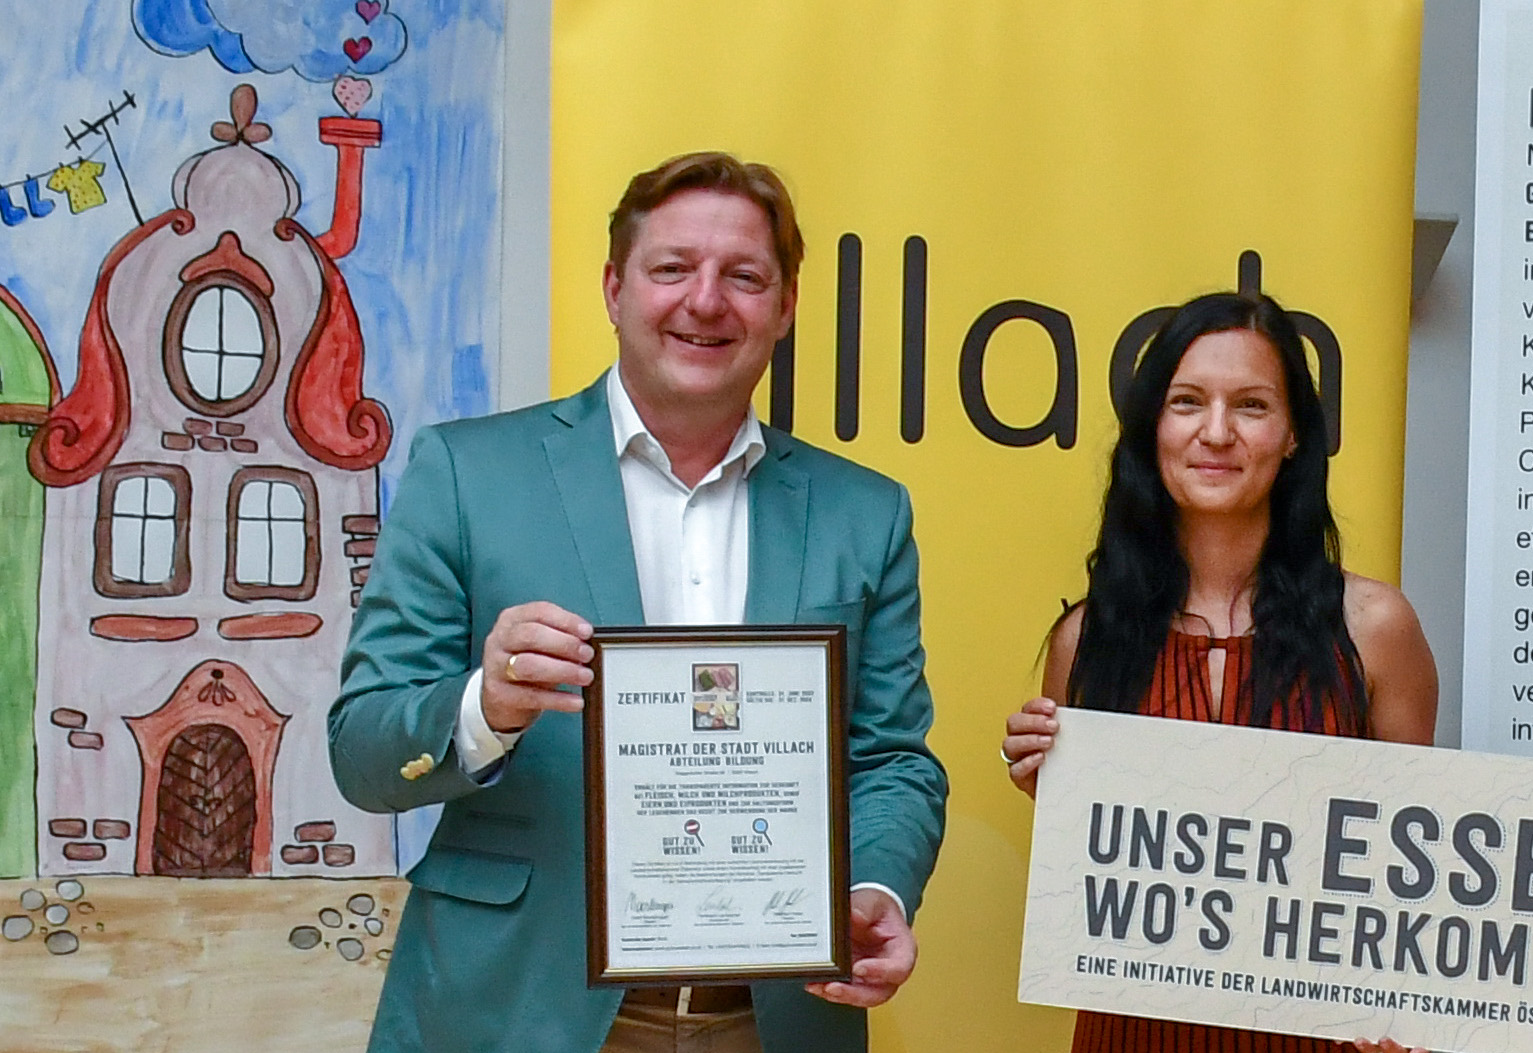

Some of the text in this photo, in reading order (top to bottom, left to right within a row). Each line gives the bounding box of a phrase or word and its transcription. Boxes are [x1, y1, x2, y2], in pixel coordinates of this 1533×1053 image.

[617, 691, 686, 705] ZERTIFIKAT
[618, 741, 815, 756] MAGISTRAT DER STADT VILLACH
[670, 756, 765, 767] ABTEILUNG BILDUNG
[662, 836, 695, 846] GUT ZU
[731, 835, 763, 845] GUT ZU
[1087, 801, 1294, 888] UNSER
[663, 846, 701, 856] WISSEN!
[731, 845, 769, 854] WISSEN!
[1076, 954, 1118, 977] EINE
[1123, 960, 1216, 988] INITIATIVE
[1221, 972, 1255, 993] DER
[1261, 976, 1511, 1022] LANDWIRTSCHAFTSKAMMER
